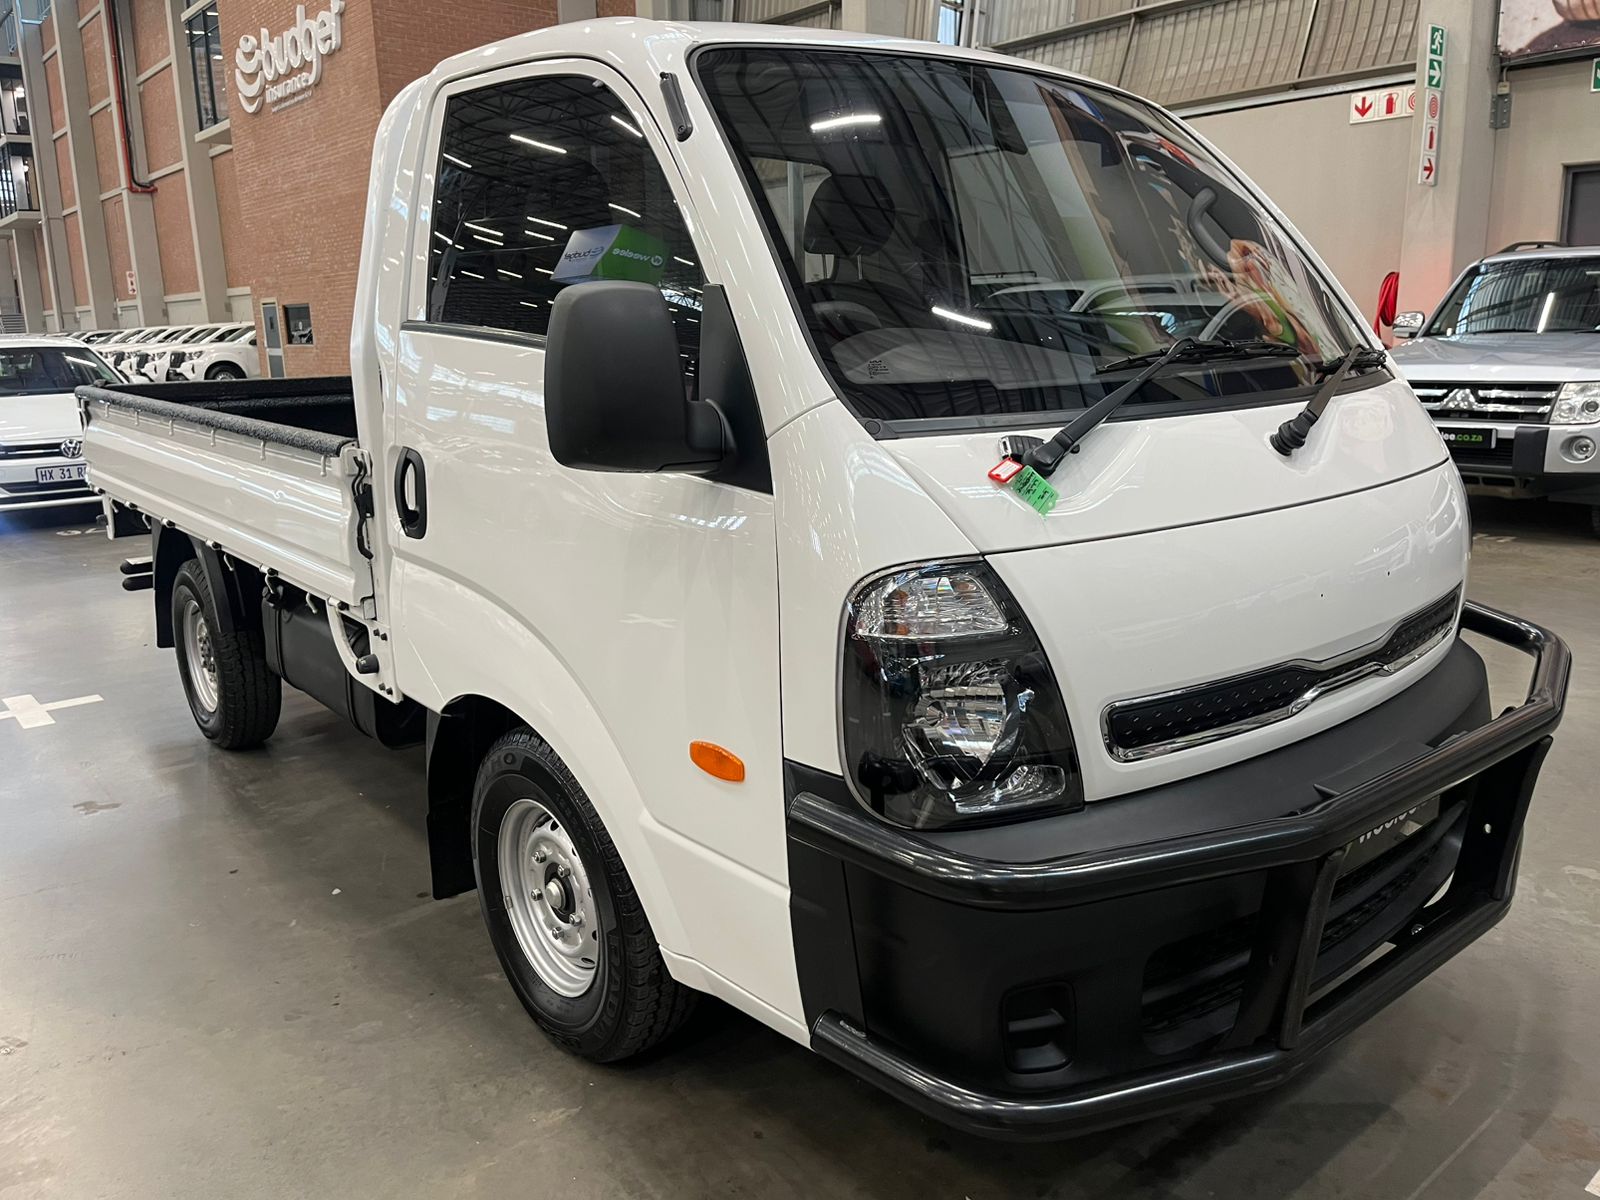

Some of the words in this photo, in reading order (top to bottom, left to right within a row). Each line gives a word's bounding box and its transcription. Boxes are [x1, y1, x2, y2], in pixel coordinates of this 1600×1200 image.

[260, 0, 345, 87] budget
[40, 469, 55, 481] HX
[59, 468, 73, 480] 31
